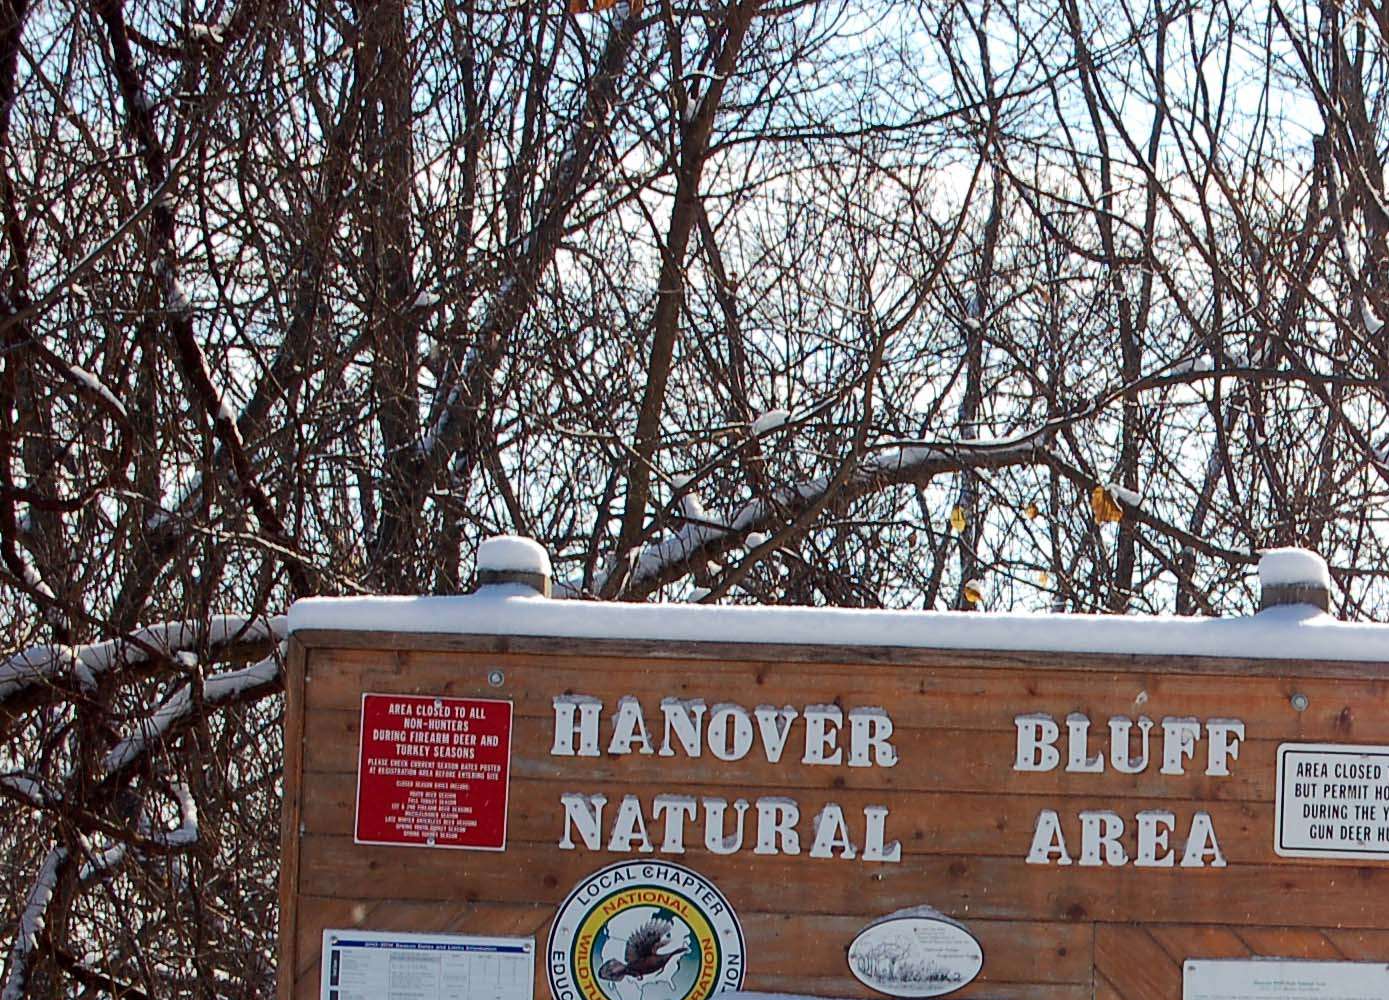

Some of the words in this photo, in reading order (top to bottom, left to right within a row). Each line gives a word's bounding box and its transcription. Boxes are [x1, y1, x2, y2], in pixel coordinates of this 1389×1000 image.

[389, 704, 412, 715] AREA
[416, 704, 450, 717] CLOSED
[455, 707, 465, 718] TO
[470, 708, 486, 719] ALL
[404, 718, 469, 732] NON-HUNTERS
[373, 729, 406, 742] DURING
[410, 731, 450, 744] FIREARM
[454, 734, 476, 746] DEER
[481, 736, 499, 747] AND
[551, 698, 898, 767] HANOVER
[1013, 714, 1245, 776] BLUFF
[396, 744, 430, 757] TURKEY
[434, 746, 475, 759] SEASONS
[368, 758, 388, 768] PLEASE
[369, 767, 376, 775] AT
[1296, 763, 1328, 778] AREA
[1335, 764, 1381, 780] CLOSED
[1295, 783, 1317, 798] BUT
[1324, 784, 1369, 800] PERMIT
[1303, 804, 1348, 820] DURING
[1355, 805, 1376, 821] THE
[558, 796, 901, 862] NATURAL
[1025, 809, 1228, 867] AREA
[1310, 825, 1333, 840] GUN
[1341, 826, 1371, 841] DEER
[577, 868, 636, 906] LOCAL
[642, 866, 724, 917] CHAPTER
[603, 891, 689, 918] NATIONAL
[577, 934, 592, 980] WILD
